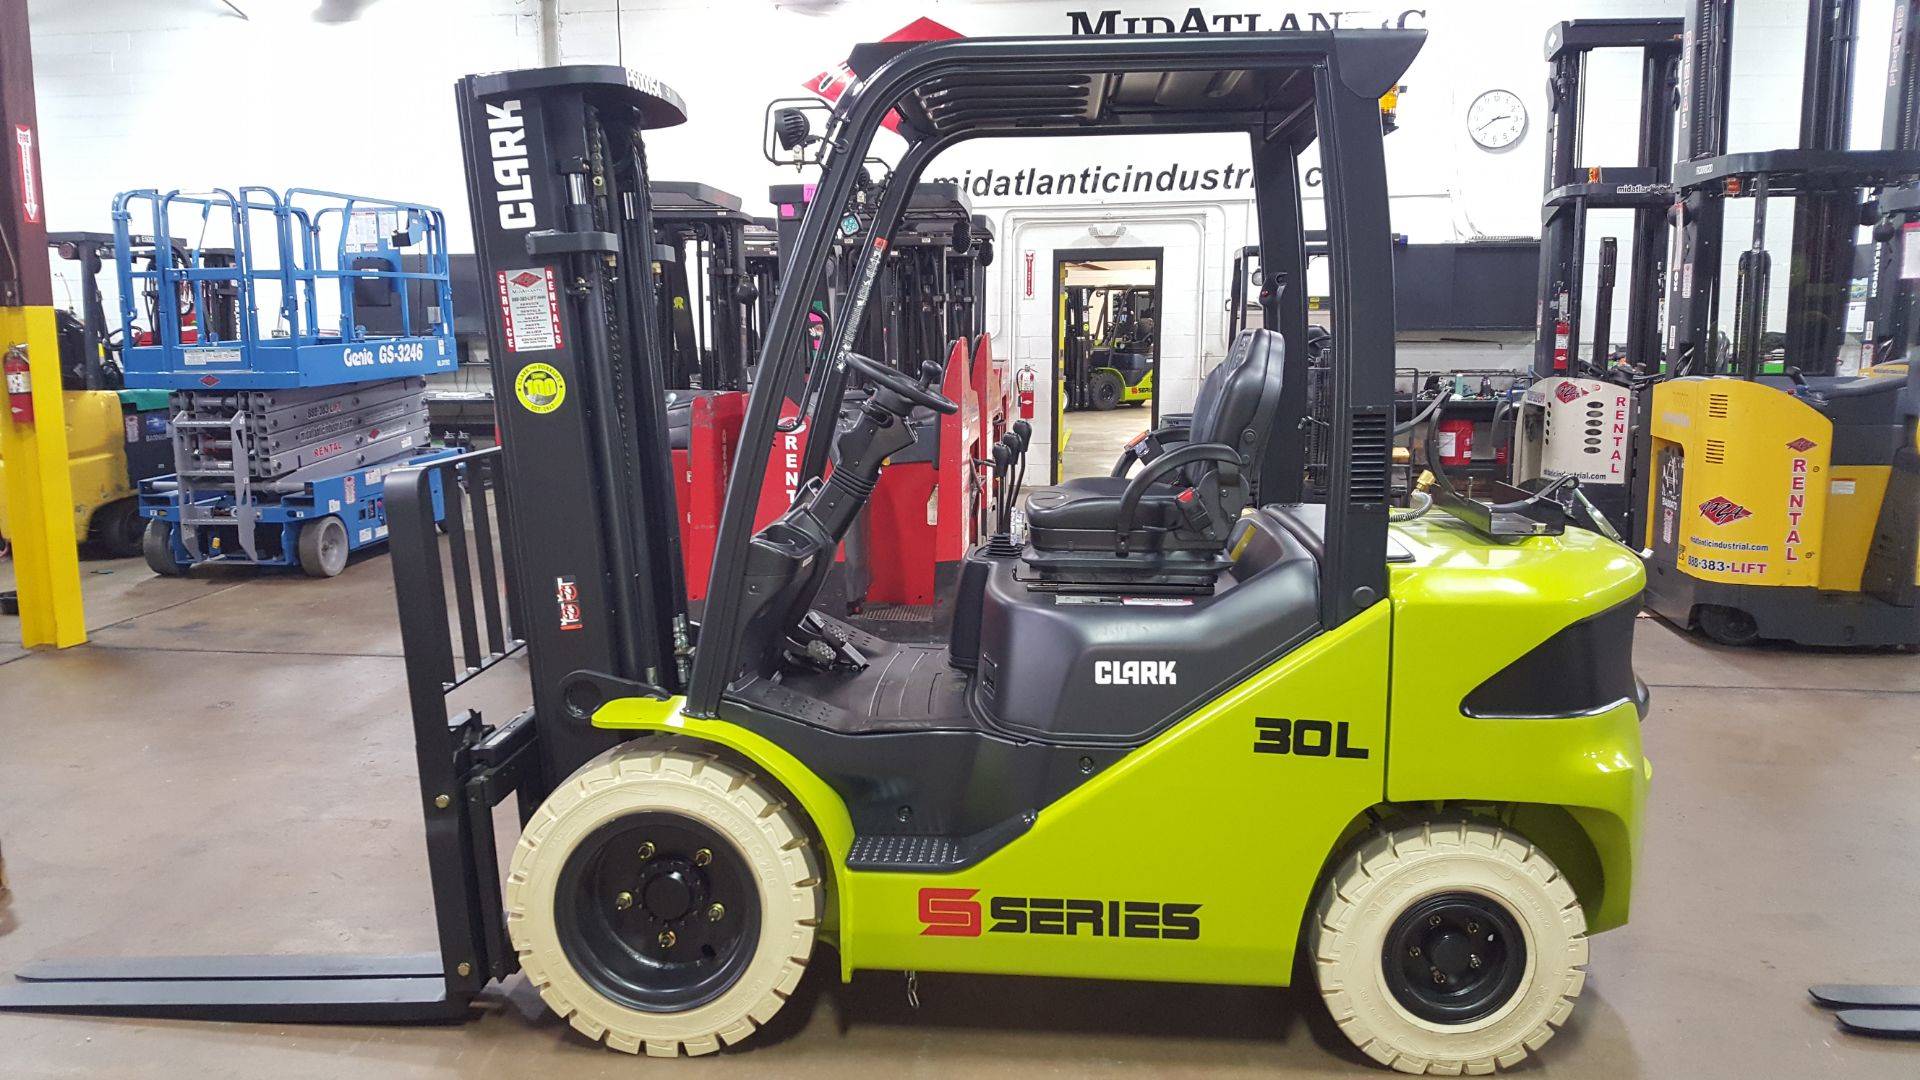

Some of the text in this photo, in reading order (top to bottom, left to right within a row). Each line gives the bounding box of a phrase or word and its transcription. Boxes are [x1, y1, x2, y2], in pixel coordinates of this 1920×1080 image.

[1066, 8, 1427, 35] MIDATLANC
[485, 99, 537, 230] CLARK
[499, 274, 514, 348] SERVICE
[546, 270, 562, 344] RENTALS
[344, 348, 374, 367] Genie
[379, 343, 423, 364] GS-3246
[313, 443, 343, 457] RENTAL
[1611, 396, 1627, 474] RENTAL
[785, 435, 798, 504] RENT
[1786, 458, 1807, 562] RENTAL
[1094, 660, 1177, 685] CLARK
[1253, 717, 1369, 760] 30L
[918, 887, 1204, 940] S SERIES
